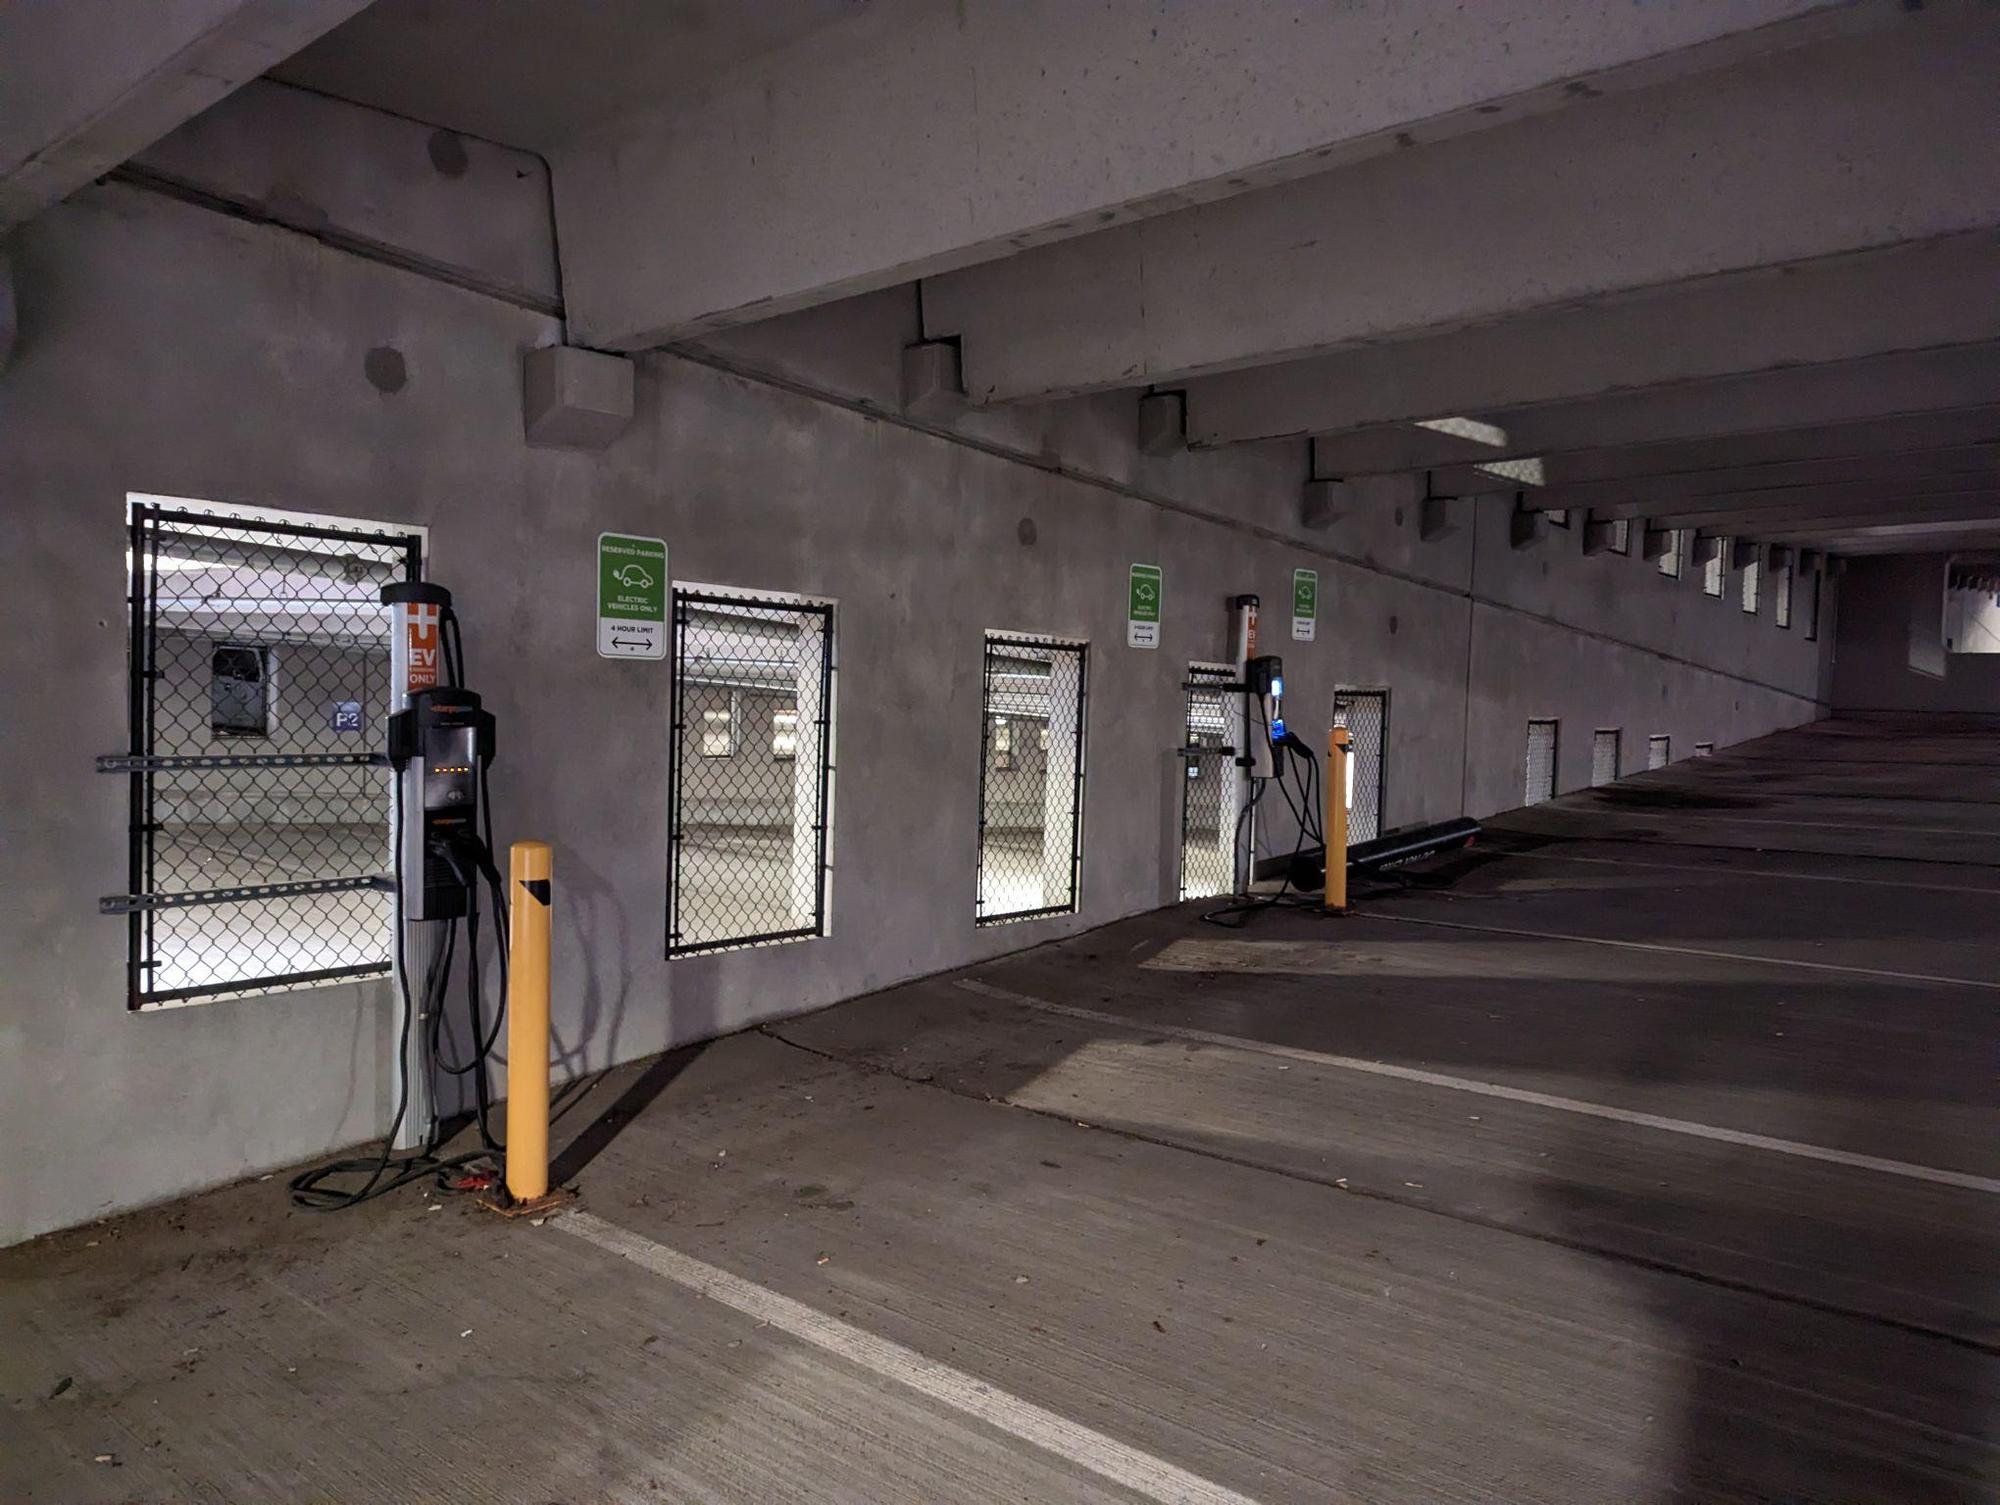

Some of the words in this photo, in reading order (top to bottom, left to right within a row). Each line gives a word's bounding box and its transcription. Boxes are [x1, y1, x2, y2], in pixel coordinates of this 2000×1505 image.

[617, 595, 648, 604] ELECTRIC
[640, 605, 657, 613] ONLY
[409, 648, 436, 667] EV
[409, 673, 436, 684] ONLY
[336, 712, 358, 727] P2
